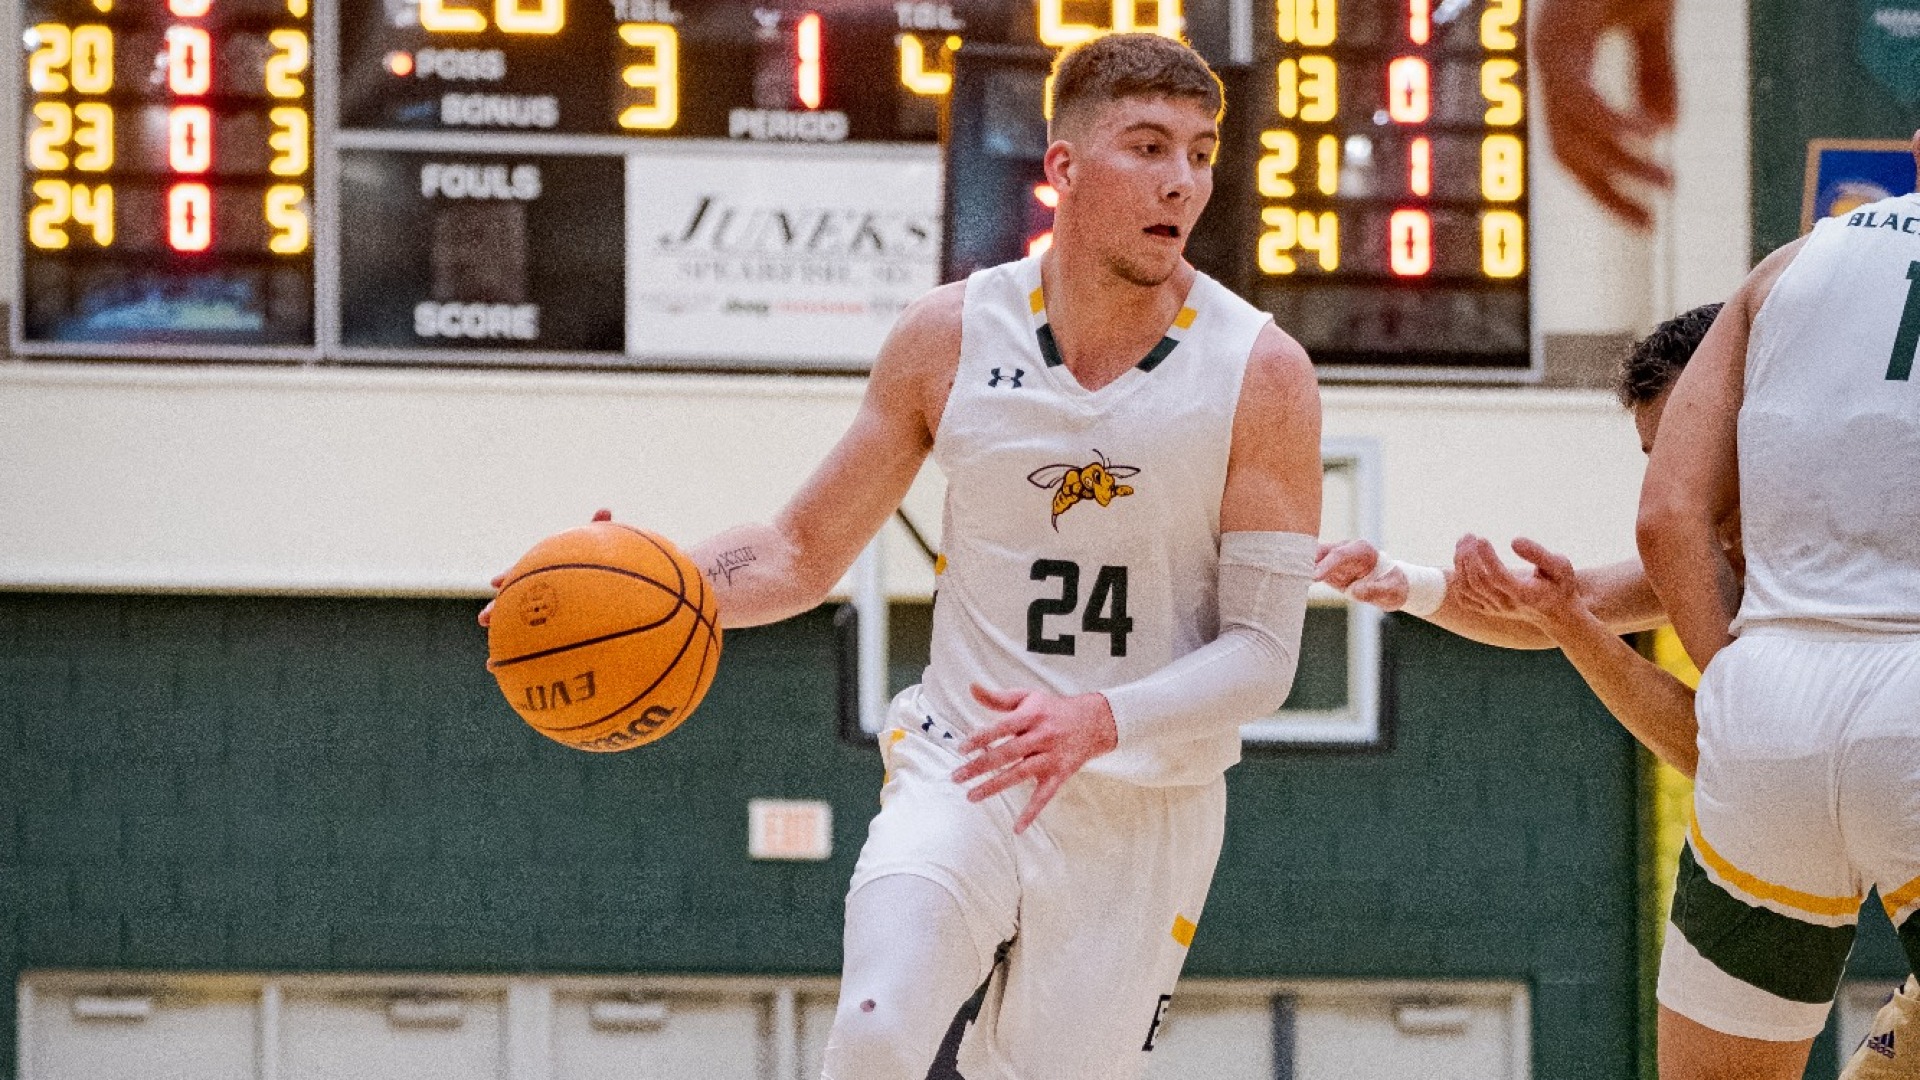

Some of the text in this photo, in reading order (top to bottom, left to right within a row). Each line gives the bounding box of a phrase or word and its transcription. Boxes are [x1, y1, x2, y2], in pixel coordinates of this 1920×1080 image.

[30, 24, 309, 98] 20 0 2
[618, 24, 678, 129] 3
[798, 13, 820, 108] 1
[1278, 56, 1522, 125] 13 0 5
[30, 102, 309, 176] 23 0 3
[441, 94, 558, 127] BONUS
[728, 108, 848, 141] PERIOD
[421, 165, 542, 199] FOULS
[1258, 131, 1522, 201] 21 1 8
[30, 180, 309, 253] 24 0 5
[1259, 207, 1523, 278] 24 0 0
[1847, 202, 1920, 235] BLAC
[414, 302, 540, 339] SCORE
[1027, 559, 1133, 657] 24
